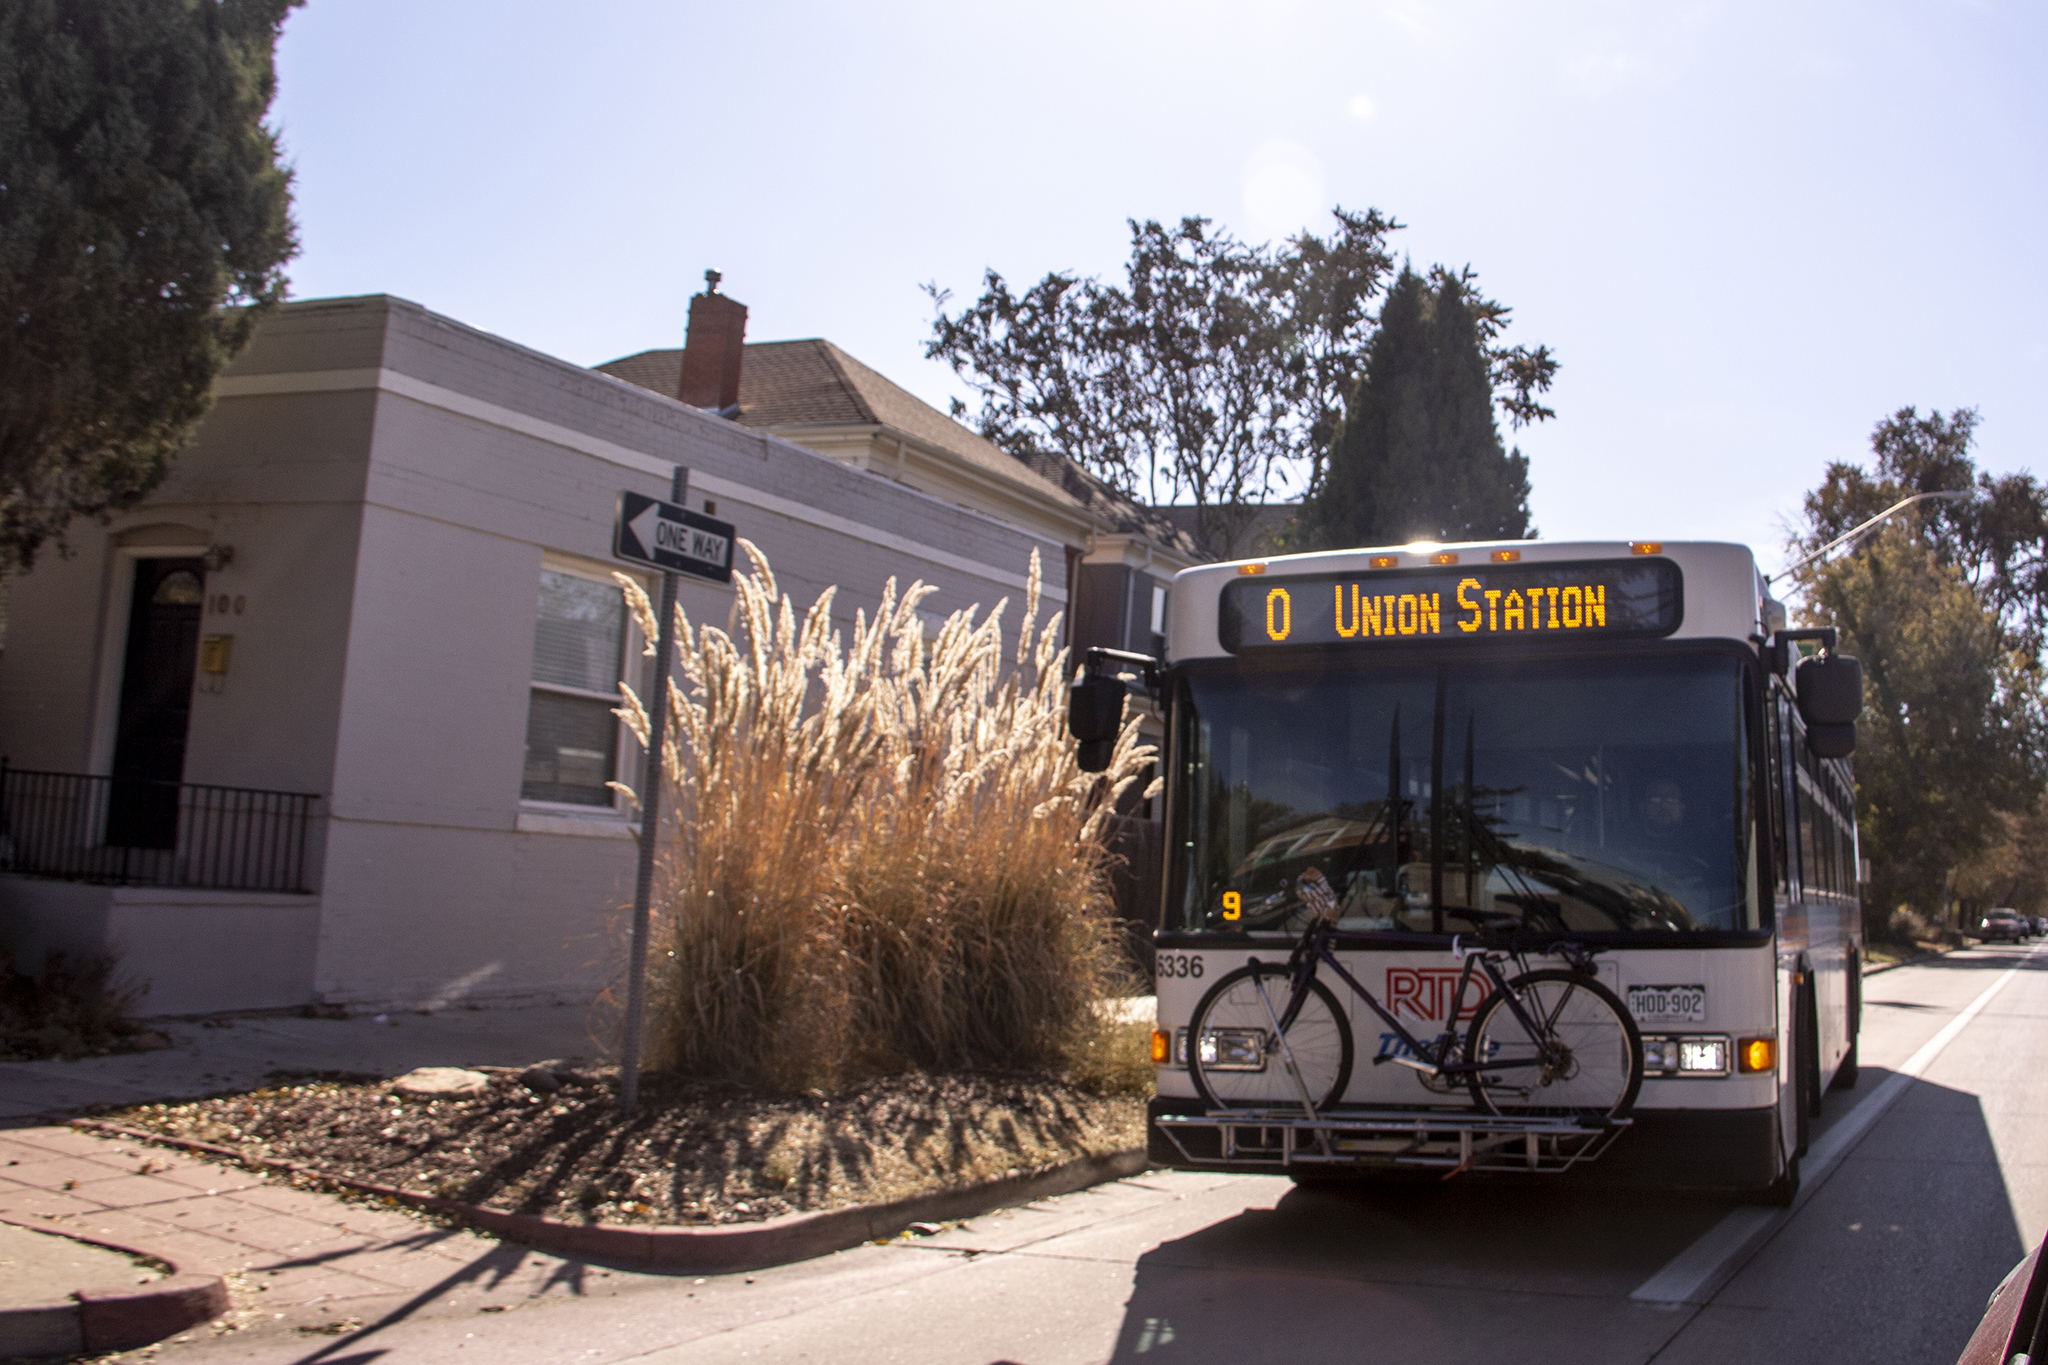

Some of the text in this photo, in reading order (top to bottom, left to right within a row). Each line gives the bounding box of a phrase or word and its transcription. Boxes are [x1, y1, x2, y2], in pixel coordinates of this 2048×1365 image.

[656, 521, 724, 561] ONE WAY
[208, 593, 246, 616] 100
[1222, 891, 1241, 921] 9
[1157, 954, 1204, 978] 6336
[1386, 967, 1496, 1021] RTD
